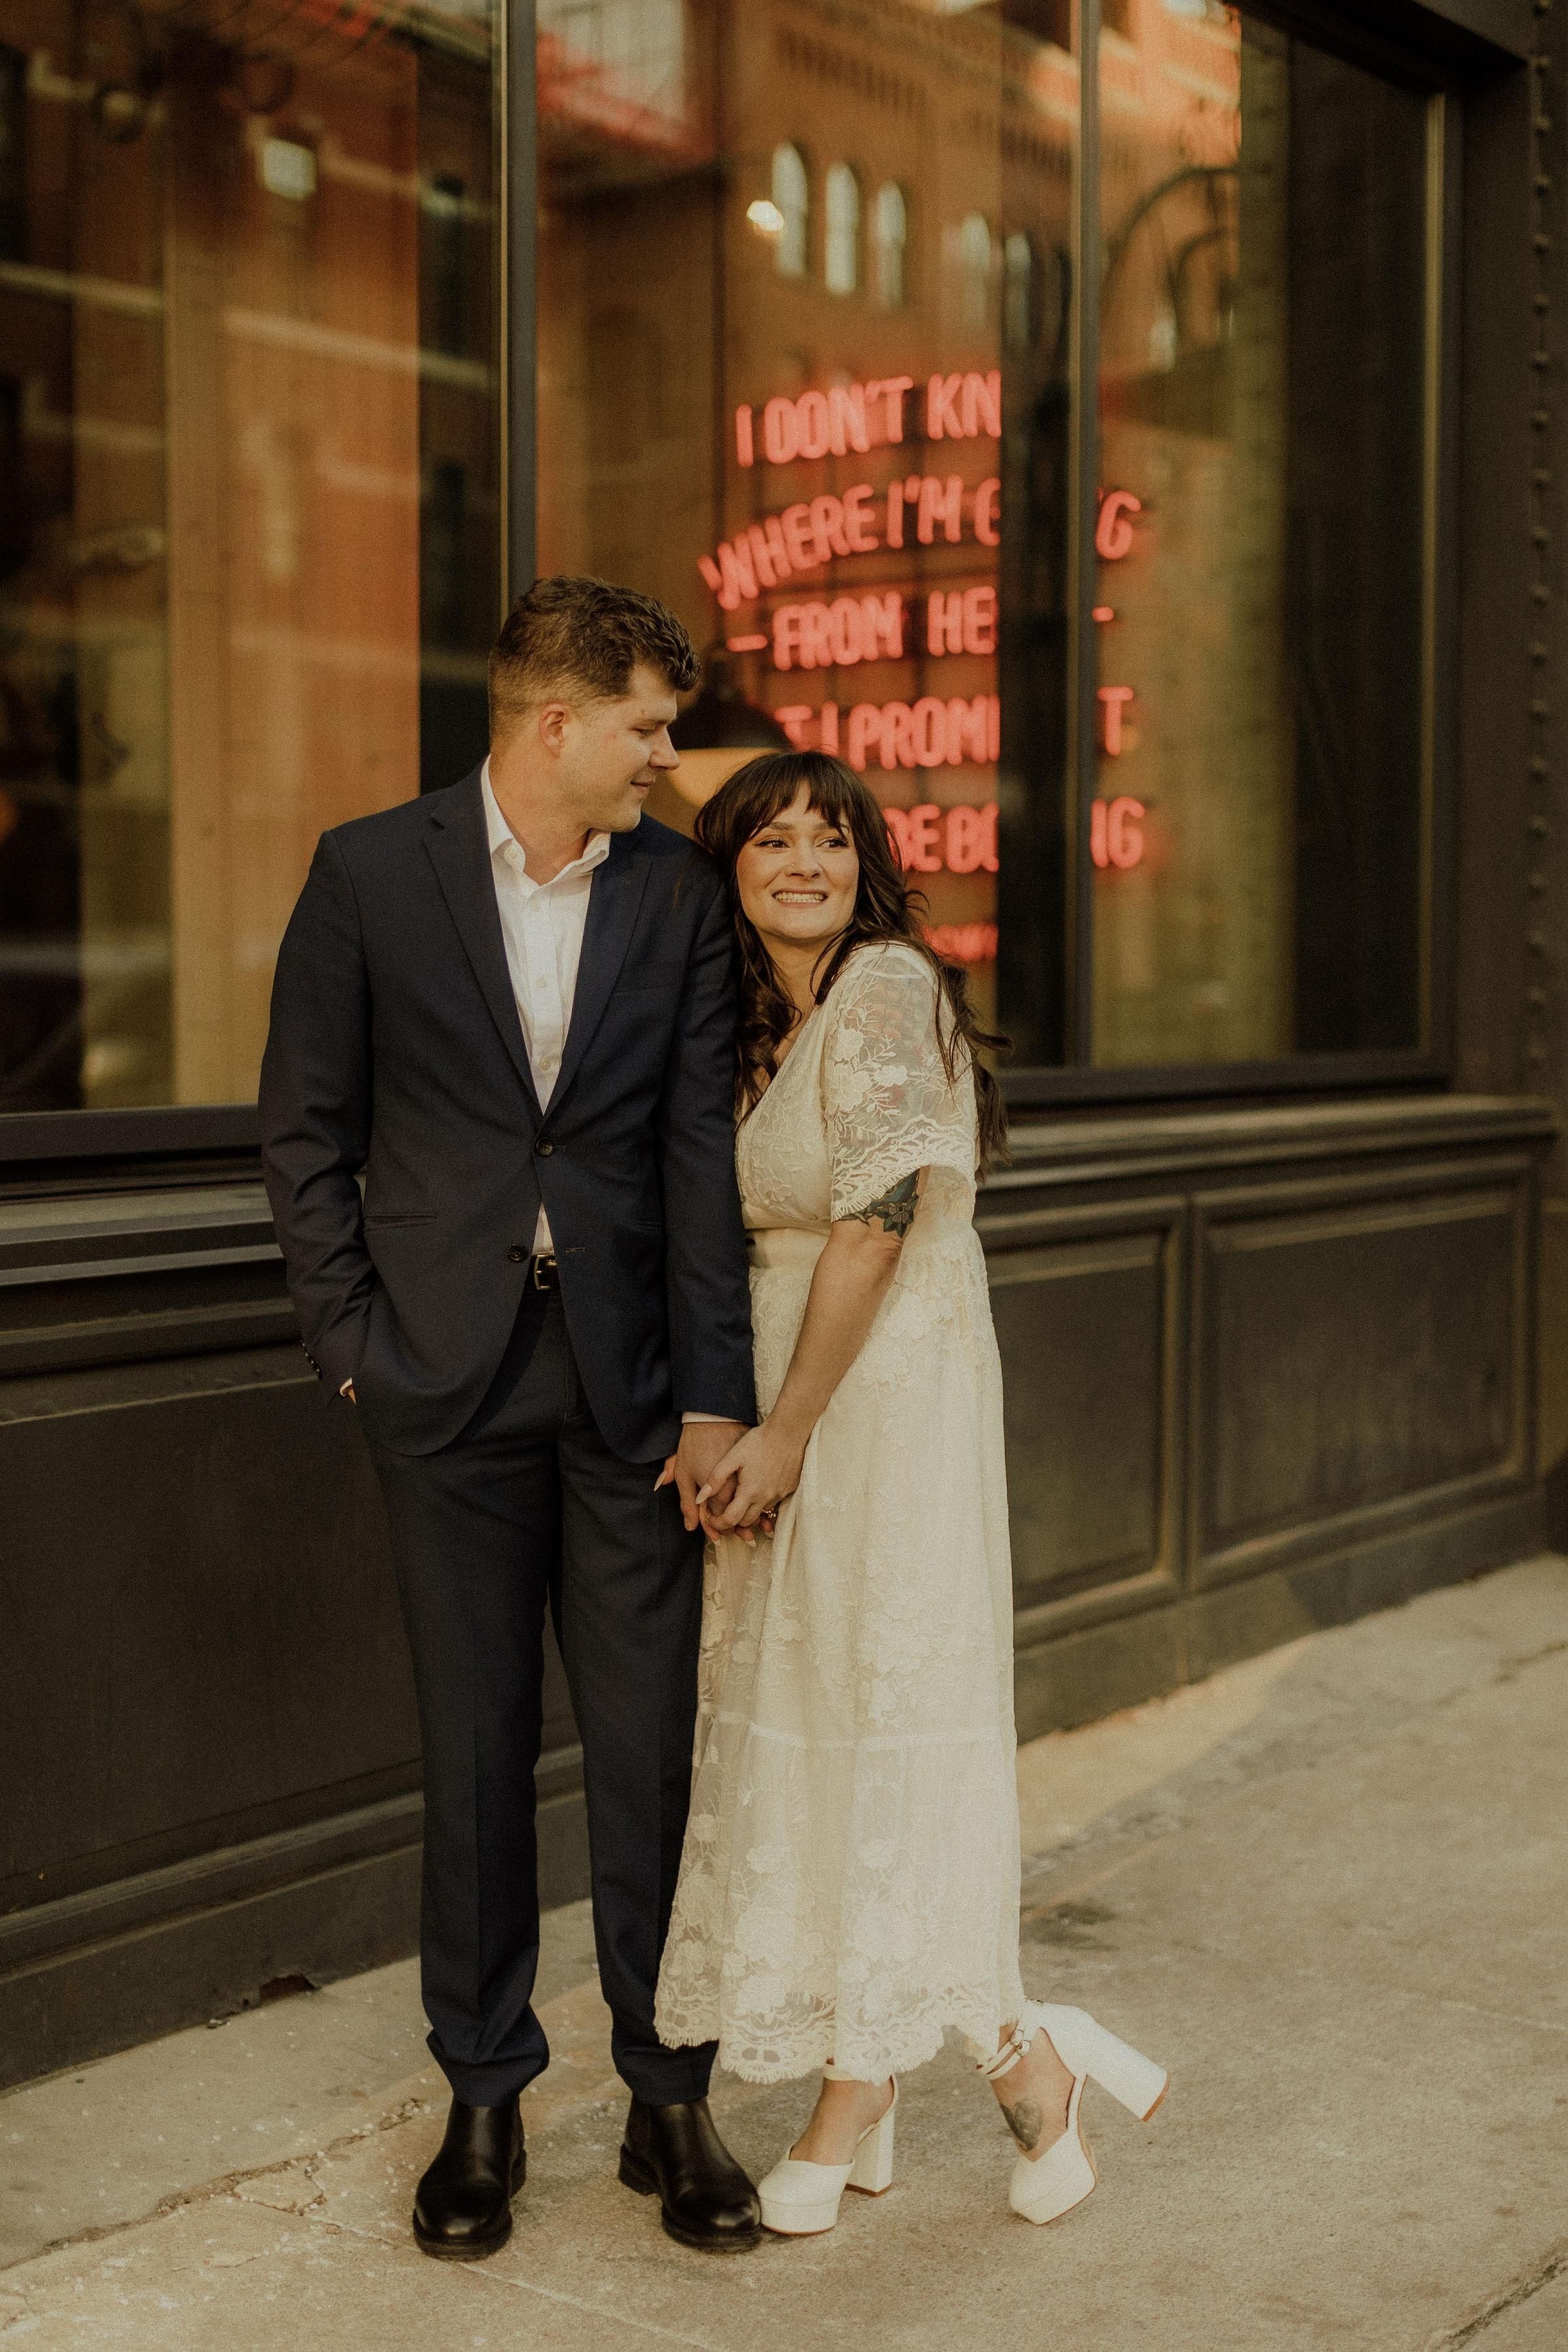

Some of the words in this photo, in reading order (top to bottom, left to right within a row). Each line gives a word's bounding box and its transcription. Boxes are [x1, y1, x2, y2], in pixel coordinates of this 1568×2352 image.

[736, 404, 753, 468] I
[764, 376, 913, 464] DON'T
[927, 369, 1001, 440] KN
[696, 483, 879, 610] WHERE
[887, 475, 962, 549] I'M
[927, 585, 998, 657] HE
[849, 694, 1000, 772] PROMI
